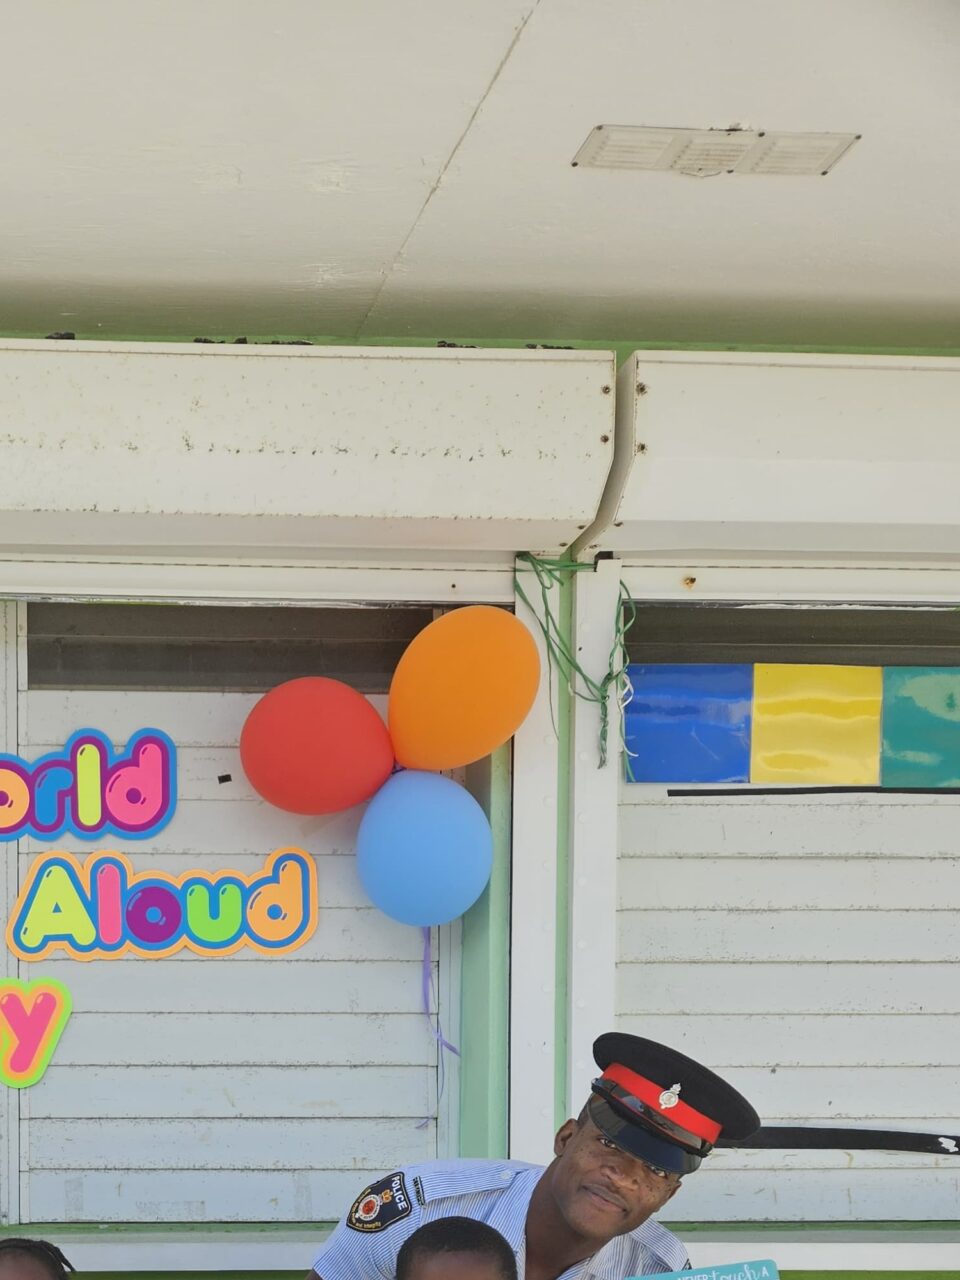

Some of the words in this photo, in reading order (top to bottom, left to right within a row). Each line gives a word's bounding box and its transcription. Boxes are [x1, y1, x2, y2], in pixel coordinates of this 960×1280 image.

[12, 853, 311, 951] Aloud
[391, 1175, 408, 1211] POLICE
[762, 1266, 769, 1278] A
